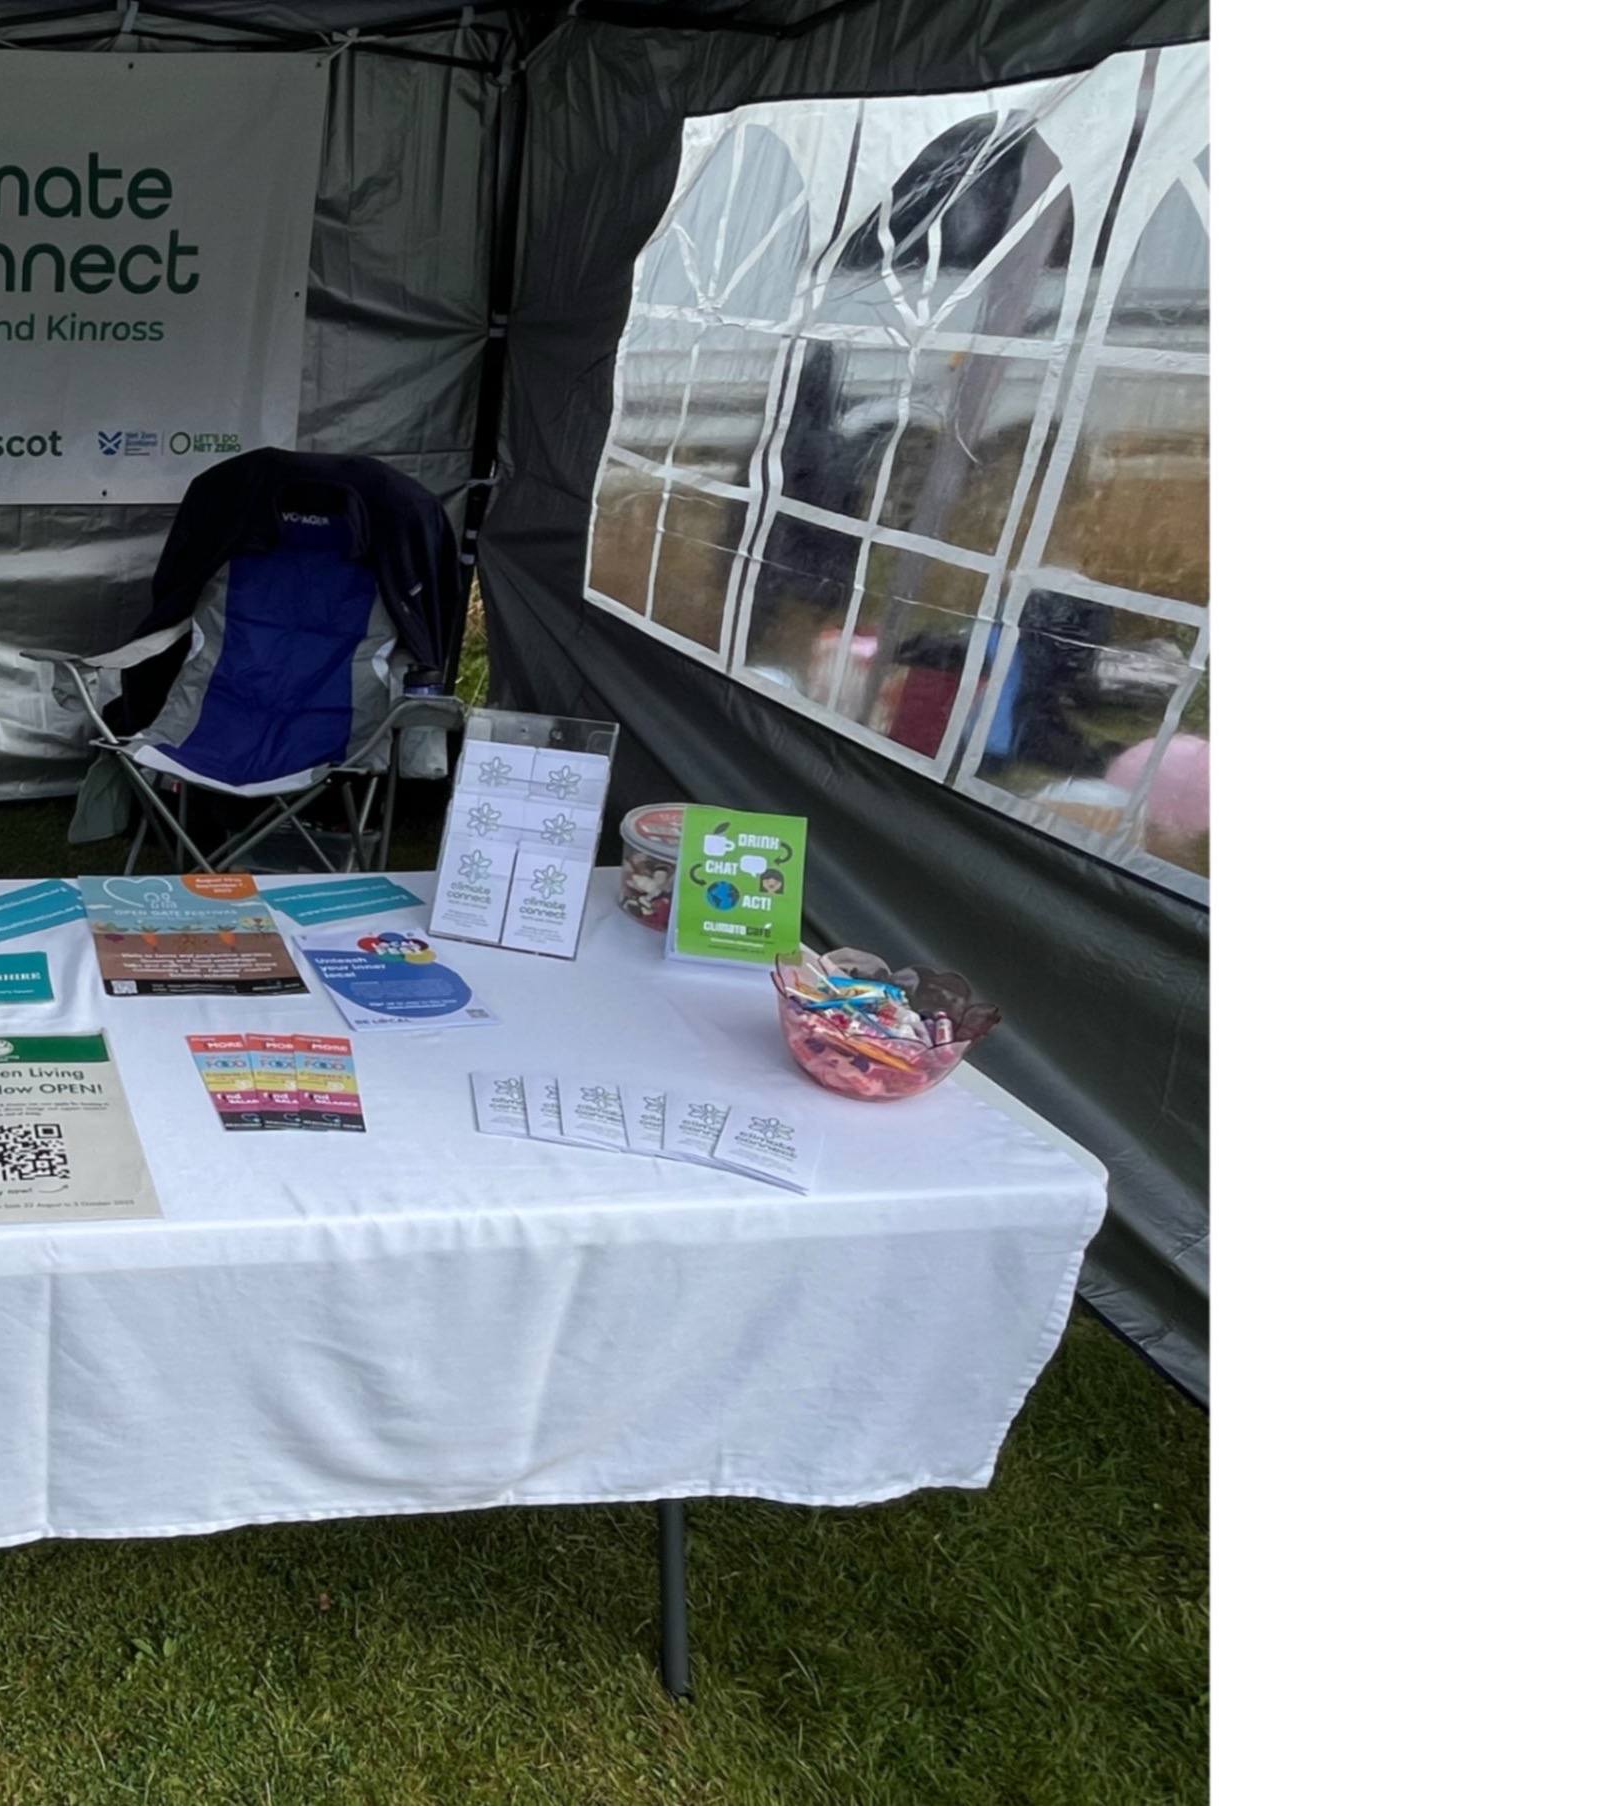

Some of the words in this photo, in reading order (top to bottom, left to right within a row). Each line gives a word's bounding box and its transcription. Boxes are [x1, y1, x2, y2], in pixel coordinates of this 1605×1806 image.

[46, 313, 165, 344] Kinross
[222, 434, 238, 443] DO
[738, 833, 780, 850] DRINK
[705, 860, 739, 876] CHAT
[451, 881, 491, 895] climate
[447, 890, 492, 905] connect
[523, 897, 566, 911] climate
[742, 895, 772, 911] ACT!
[519, 906, 567, 920] connect
[314, 957, 367, 965] Unleash
[319, 964, 349, 972] your
[311, 1043, 348, 1052] MORE
[29, 1067, 85, 1081] Living
[39, 1083, 104, 1095] OPEN!
